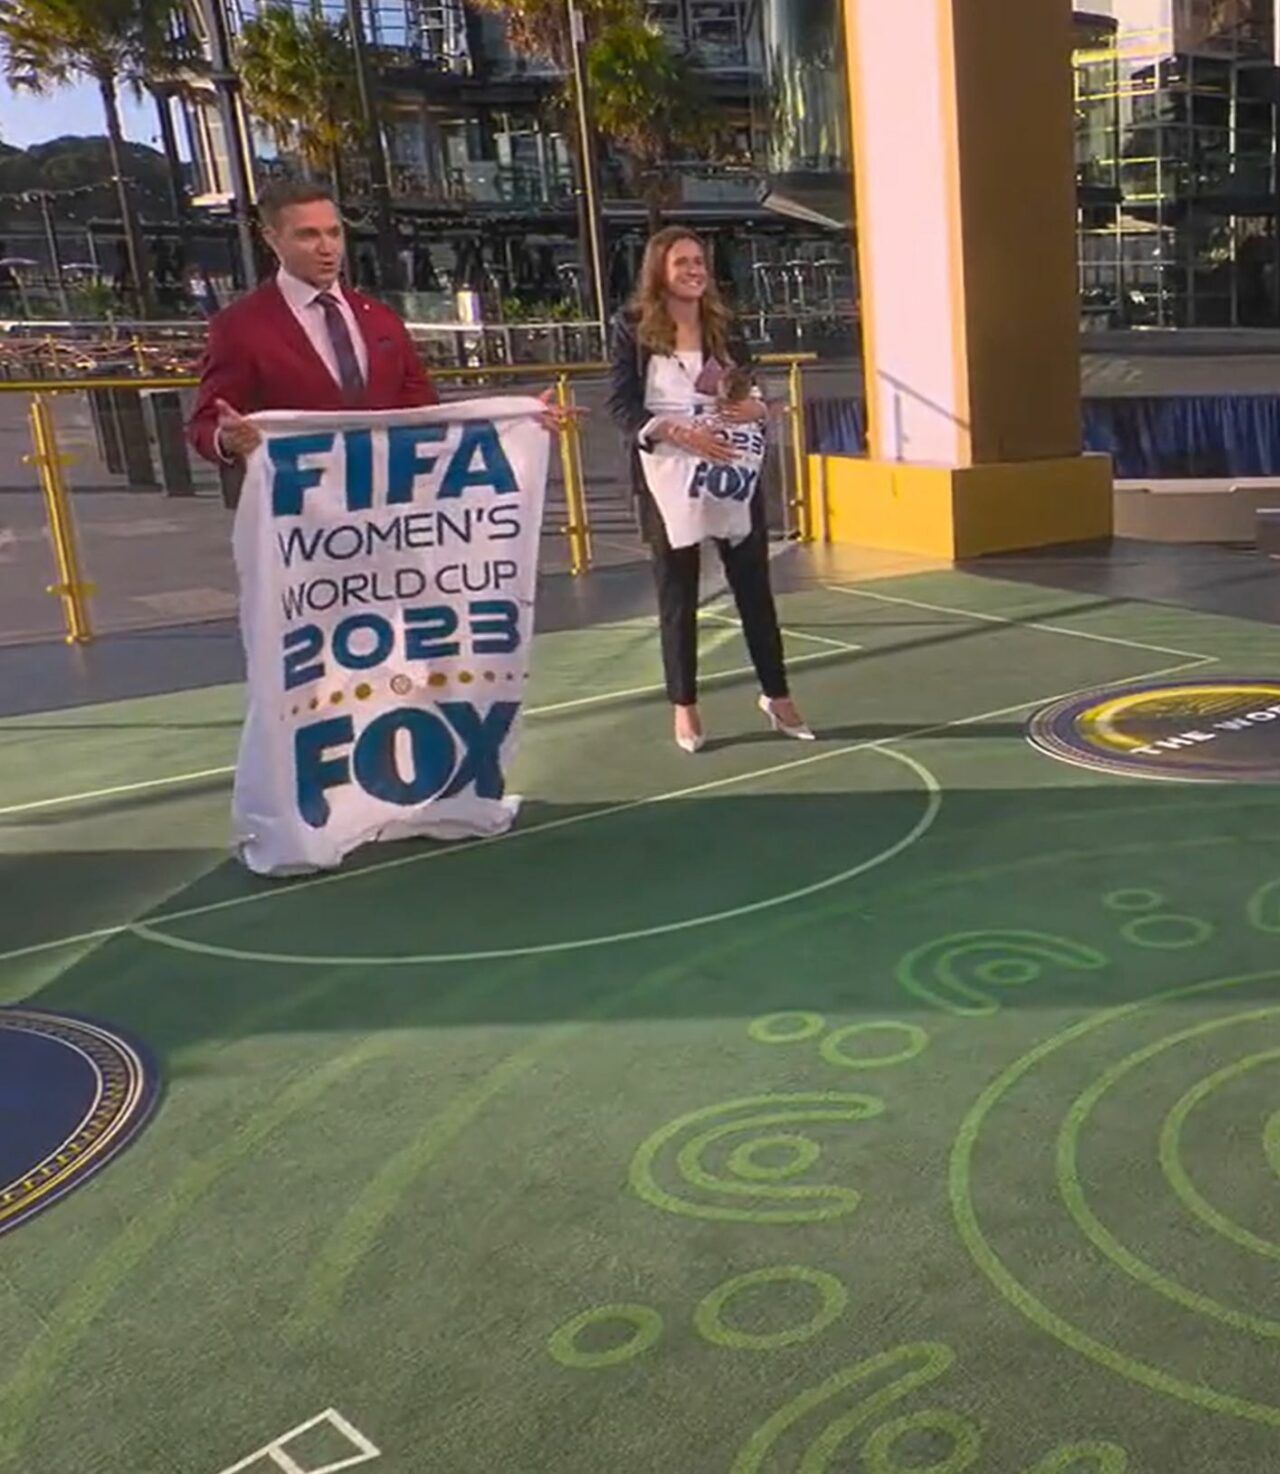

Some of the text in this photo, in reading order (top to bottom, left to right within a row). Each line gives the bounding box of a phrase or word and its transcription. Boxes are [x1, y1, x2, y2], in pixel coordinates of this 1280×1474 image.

[1236, 215, 1268, 236] THE
[267, 419, 520, 516] FIFA
[689, 462, 756, 500] FOX
[278, 504, 521, 568] WOMEN'S
[282, 560, 518, 621] WORLD CUP
[283, 600, 521, 691] 2023
[294, 700, 522, 829] FOX
[1129, 730, 1217, 757] THE
